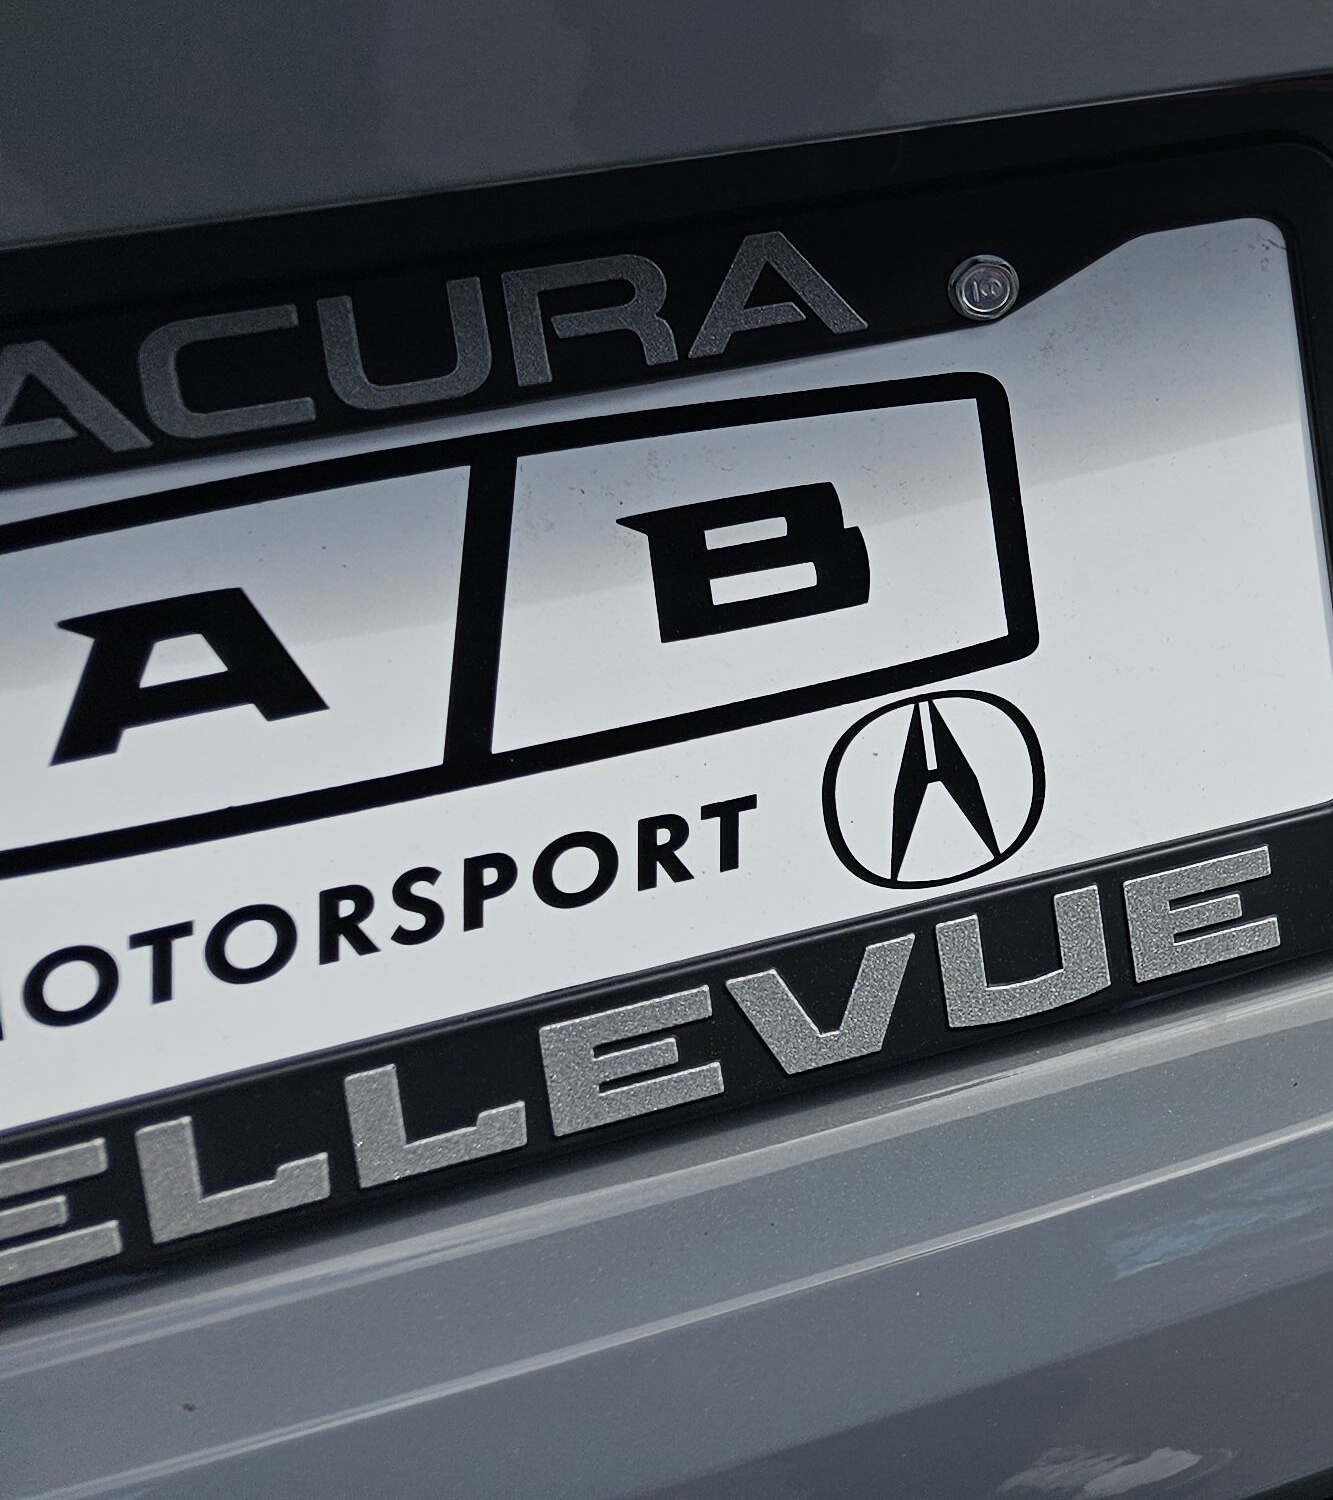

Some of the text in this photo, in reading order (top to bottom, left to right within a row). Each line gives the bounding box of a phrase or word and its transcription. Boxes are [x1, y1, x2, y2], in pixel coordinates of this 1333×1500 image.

[0, 230, 868, 452] ACURA
[50, 481, 871, 767] A B
[0, 793, 758, 1041] OTORSPORT
